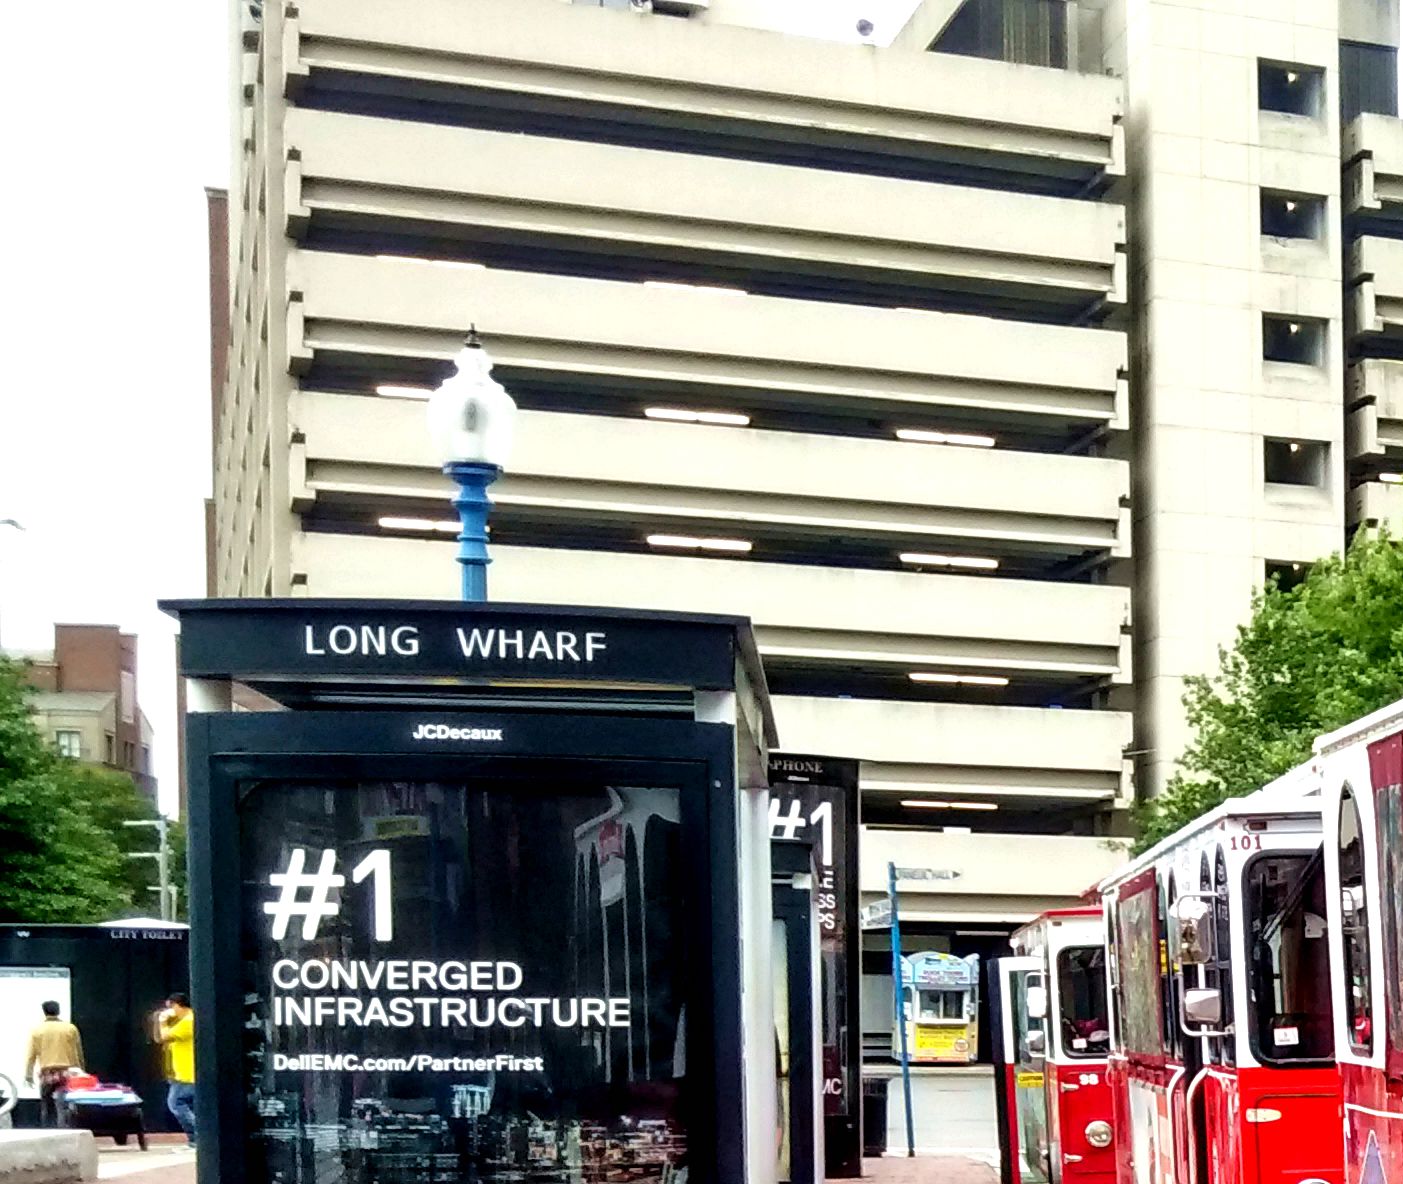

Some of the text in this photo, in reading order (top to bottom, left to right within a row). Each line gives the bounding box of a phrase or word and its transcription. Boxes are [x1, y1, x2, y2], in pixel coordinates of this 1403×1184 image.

[304, 624, 608, 662] LONG WHARF
[413, 724, 503, 741] JCDecaux
[768, 798, 833, 867] #1
[1230, 835, 1263, 851] 101
[264, 848, 395, 942] #1
[111, 930, 183, 940] CITY TOILET
[273, 958, 523, 992] CONVERGED
[273, 997, 631, 1028] INFRASTRUCTURE
[273, 1053, 544, 1073] DellEMC.com/PartnerFirst
